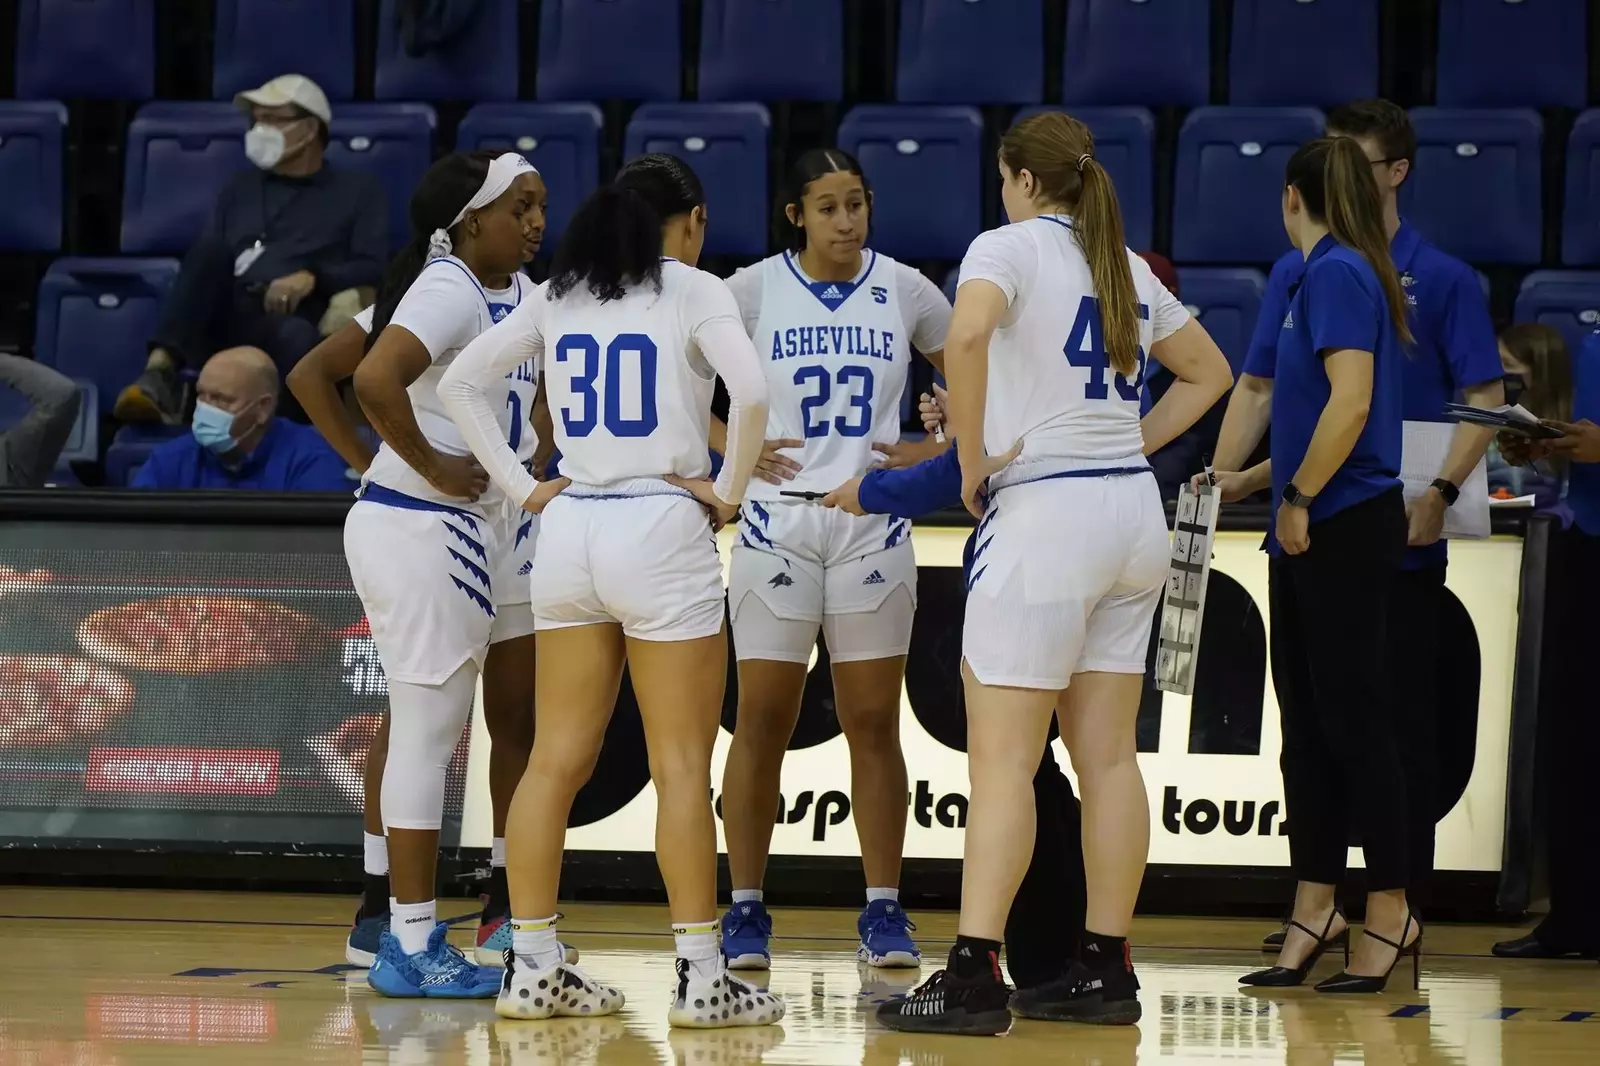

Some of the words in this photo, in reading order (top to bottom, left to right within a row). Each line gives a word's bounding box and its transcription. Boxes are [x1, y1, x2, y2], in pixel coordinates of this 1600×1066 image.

[771, 325, 893, 361] ASHEVILLE
[555, 333, 659, 437] 30
[793, 364, 874, 439] 23
[199, 760, 272, 785] NOW
[404, 915, 431, 924] adidas
